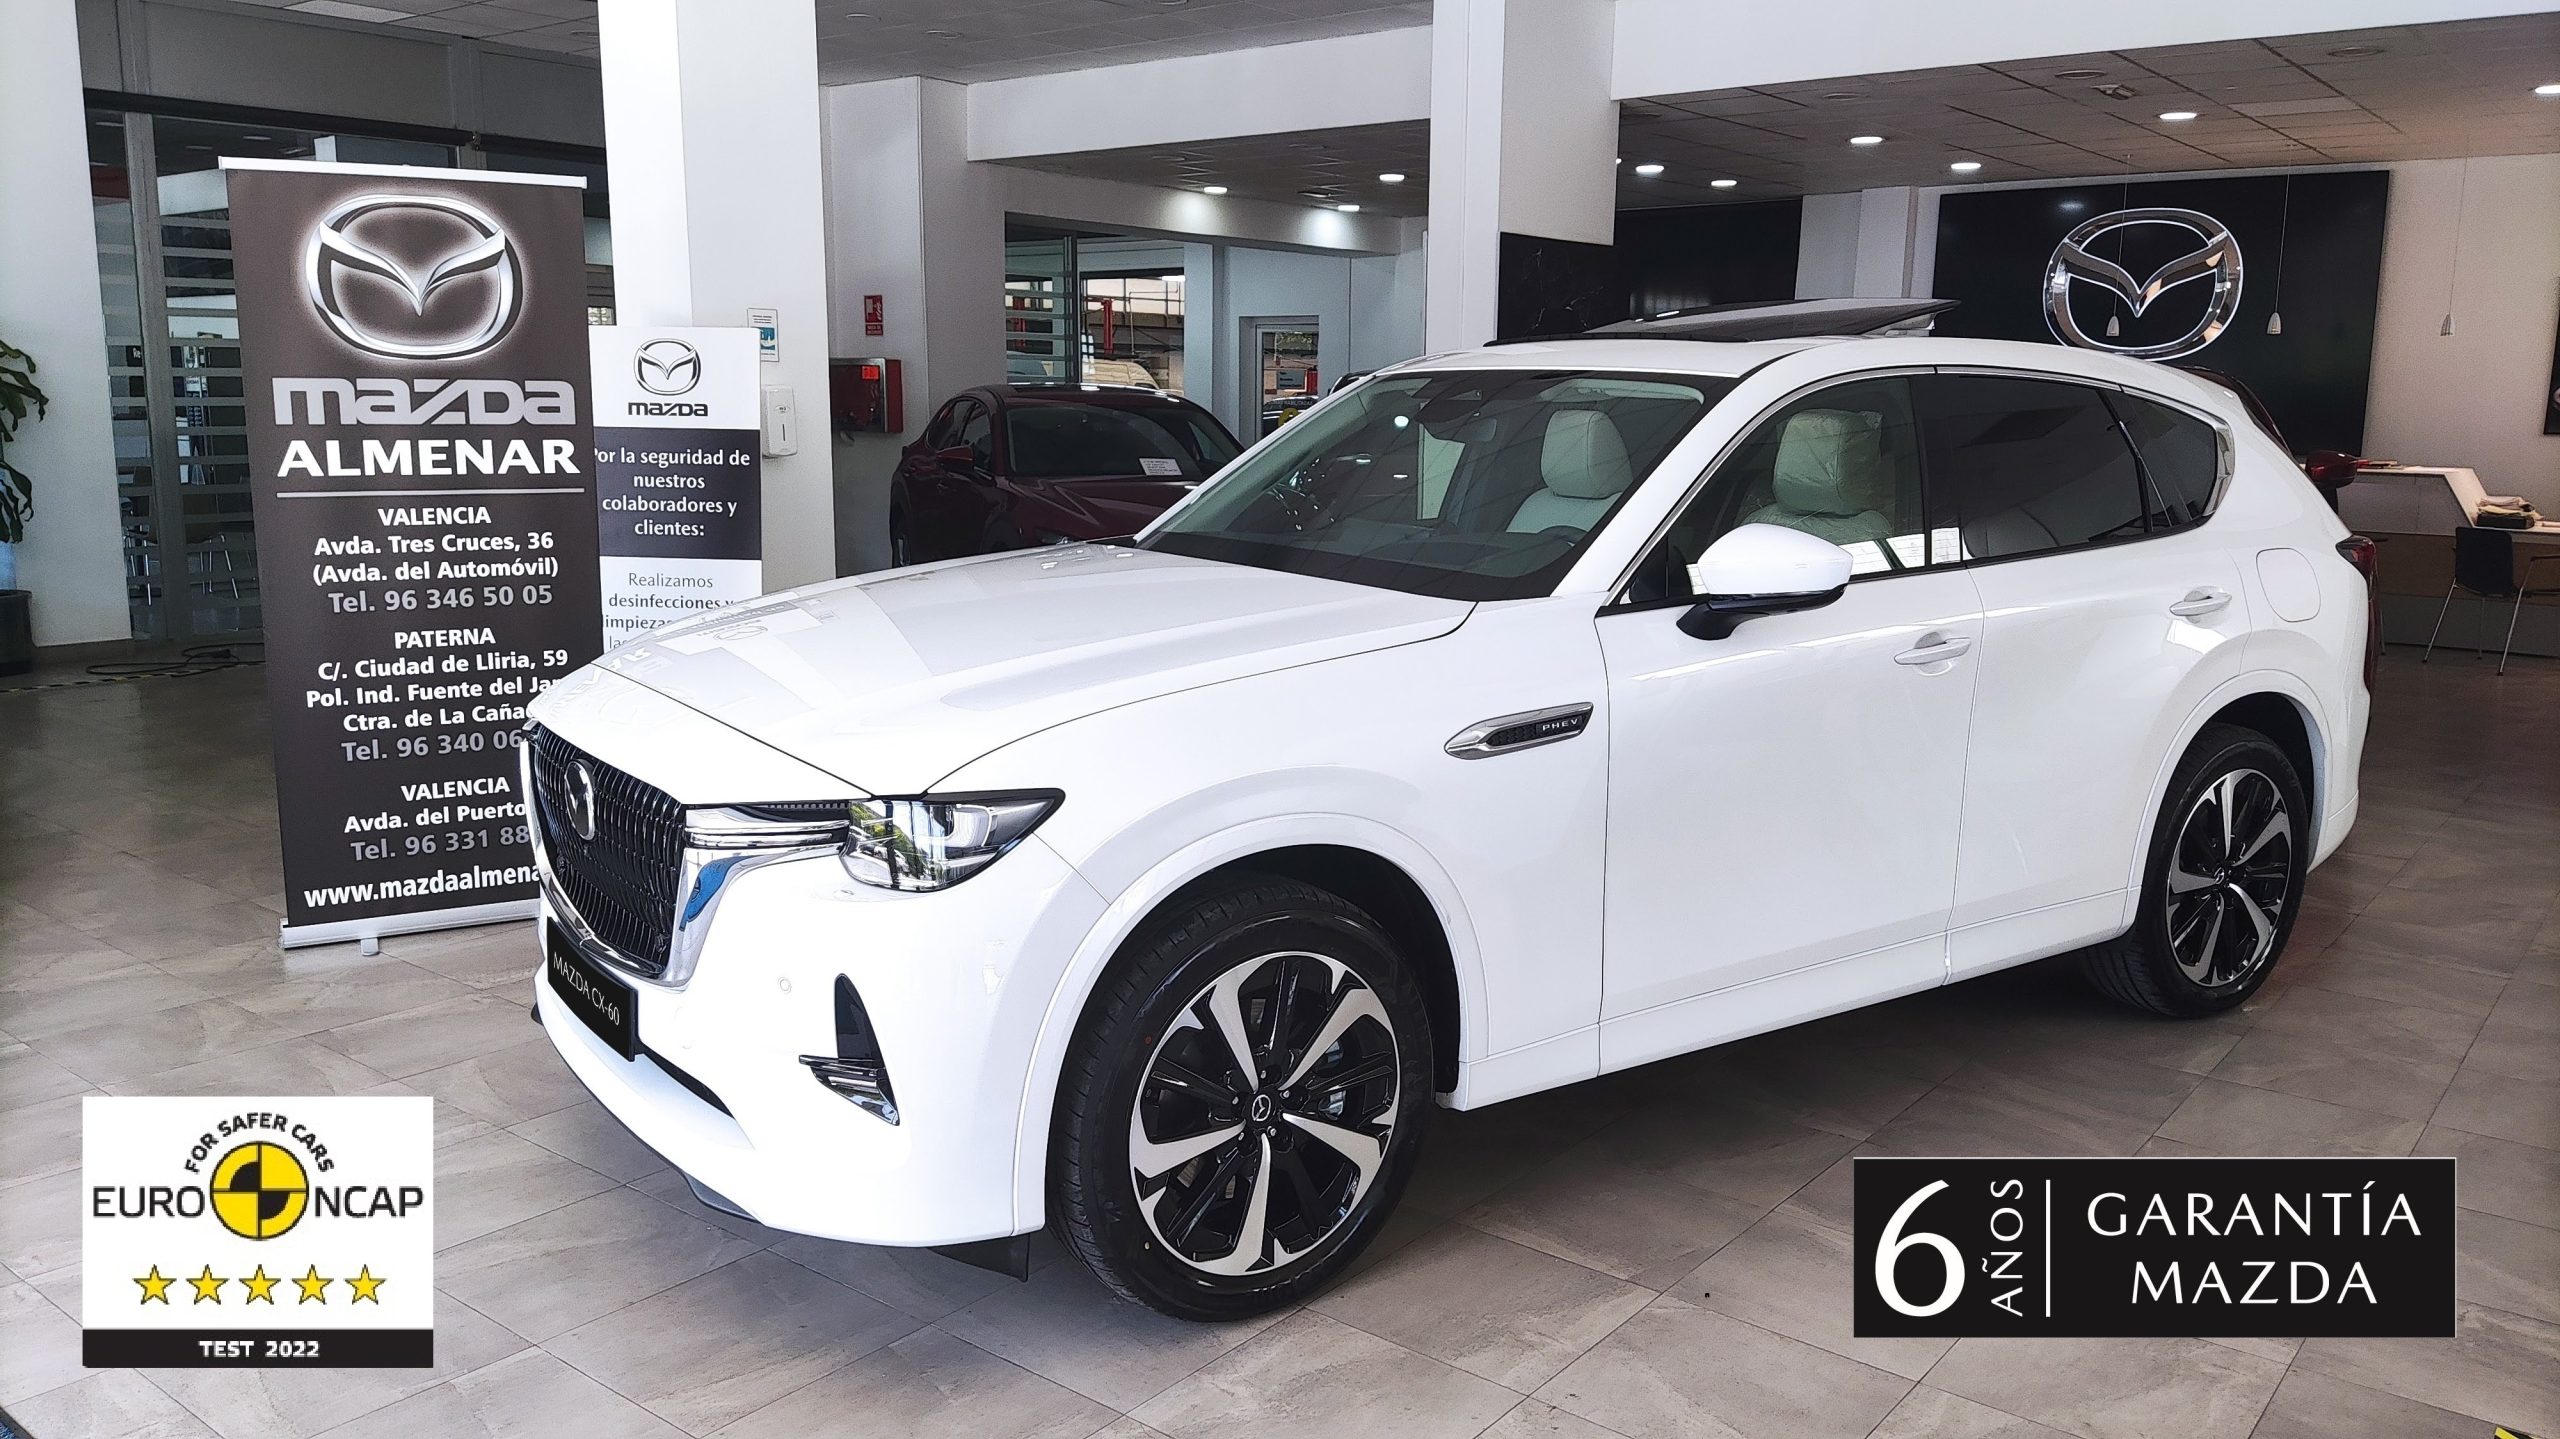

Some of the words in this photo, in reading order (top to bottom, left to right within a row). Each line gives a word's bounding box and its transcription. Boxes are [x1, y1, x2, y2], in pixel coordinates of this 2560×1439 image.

[271, 377, 577, 426] mazda
[628, 402, 708, 418] mazda
[277, 439, 581, 478] ALMENAR
[594, 448, 615, 463] or
[621, 447, 635, 463] la
[641, 449, 723, 468] seguridad
[729, 450, 750, 465] de
[634, 475, 705, 488] nuestros
[377, 507, 492, 527] VALENCIA
[602, 495, 723, 512] colaboradores
[728, 501, 737, 517] y
[635, 519, 705, 536] clientes:
[314, 536, 382, 557] Avda.
[388, 536, 435, 553] Tres
[441, 533, 522, 554] Cruces,
[527, 532, 554, 550] 36
[313, 563, 388, 586] (Avda.
[394, 561, 431, 581] del
[437, 558, 559, 582] Automóvil)
[629, 572, 713, 588] Realizamos
[328, 591, 375, 613] Tel.
[383, 591, 418, 611] 96
[426, 588, 475, 609] 346
[482, 587, 515, 607] 50
[522, 584, 553, 605] 05
[609, 593, 720, 609] desinfecciones
[394, 627, 496, 649] PATERNA
[317, 661, 348, 681] C/.
[355, 656, 435, 679] Ciudad
[441, 654, 469, 673] de
[475, 650, 535, 672] Lliria,
[543, 649, 569, 667] 59
[306, 688, 349, 708] Pol.
[356, 685, 400, 704] Ind.
[408, 681, 482, 702] Fuente
[488, 676, 521, 697] del
[343, 711, 398, 733] Ctra.
[405, 708, 433, 728] de
[439, 706, 465, 725] La
[472, 702, 529, 722] Caña
[1542, 718, 1579, 731] PHEV
[341, 740, 388, 762] Tel.
[397, 737, 429, 758] 96
[437, 732, 485, 754] 340
[491, 730, 521, 751] 06
[401, 775, 510, 801] VALENCIA
[344, 811, 409, 833] Avda.
[415, 806, 449, 827] del
[457, 802, 525, 823] Puerto
[351, 840, 397, 860] Tel.
[405, 835, 437, 856] 96
[445, 830, 489, 851] 331
[499, 826, 529, 844] 88
[553, 952, 590, 1000] MAZDA
[592, 988, 620, 1025] CX-60
